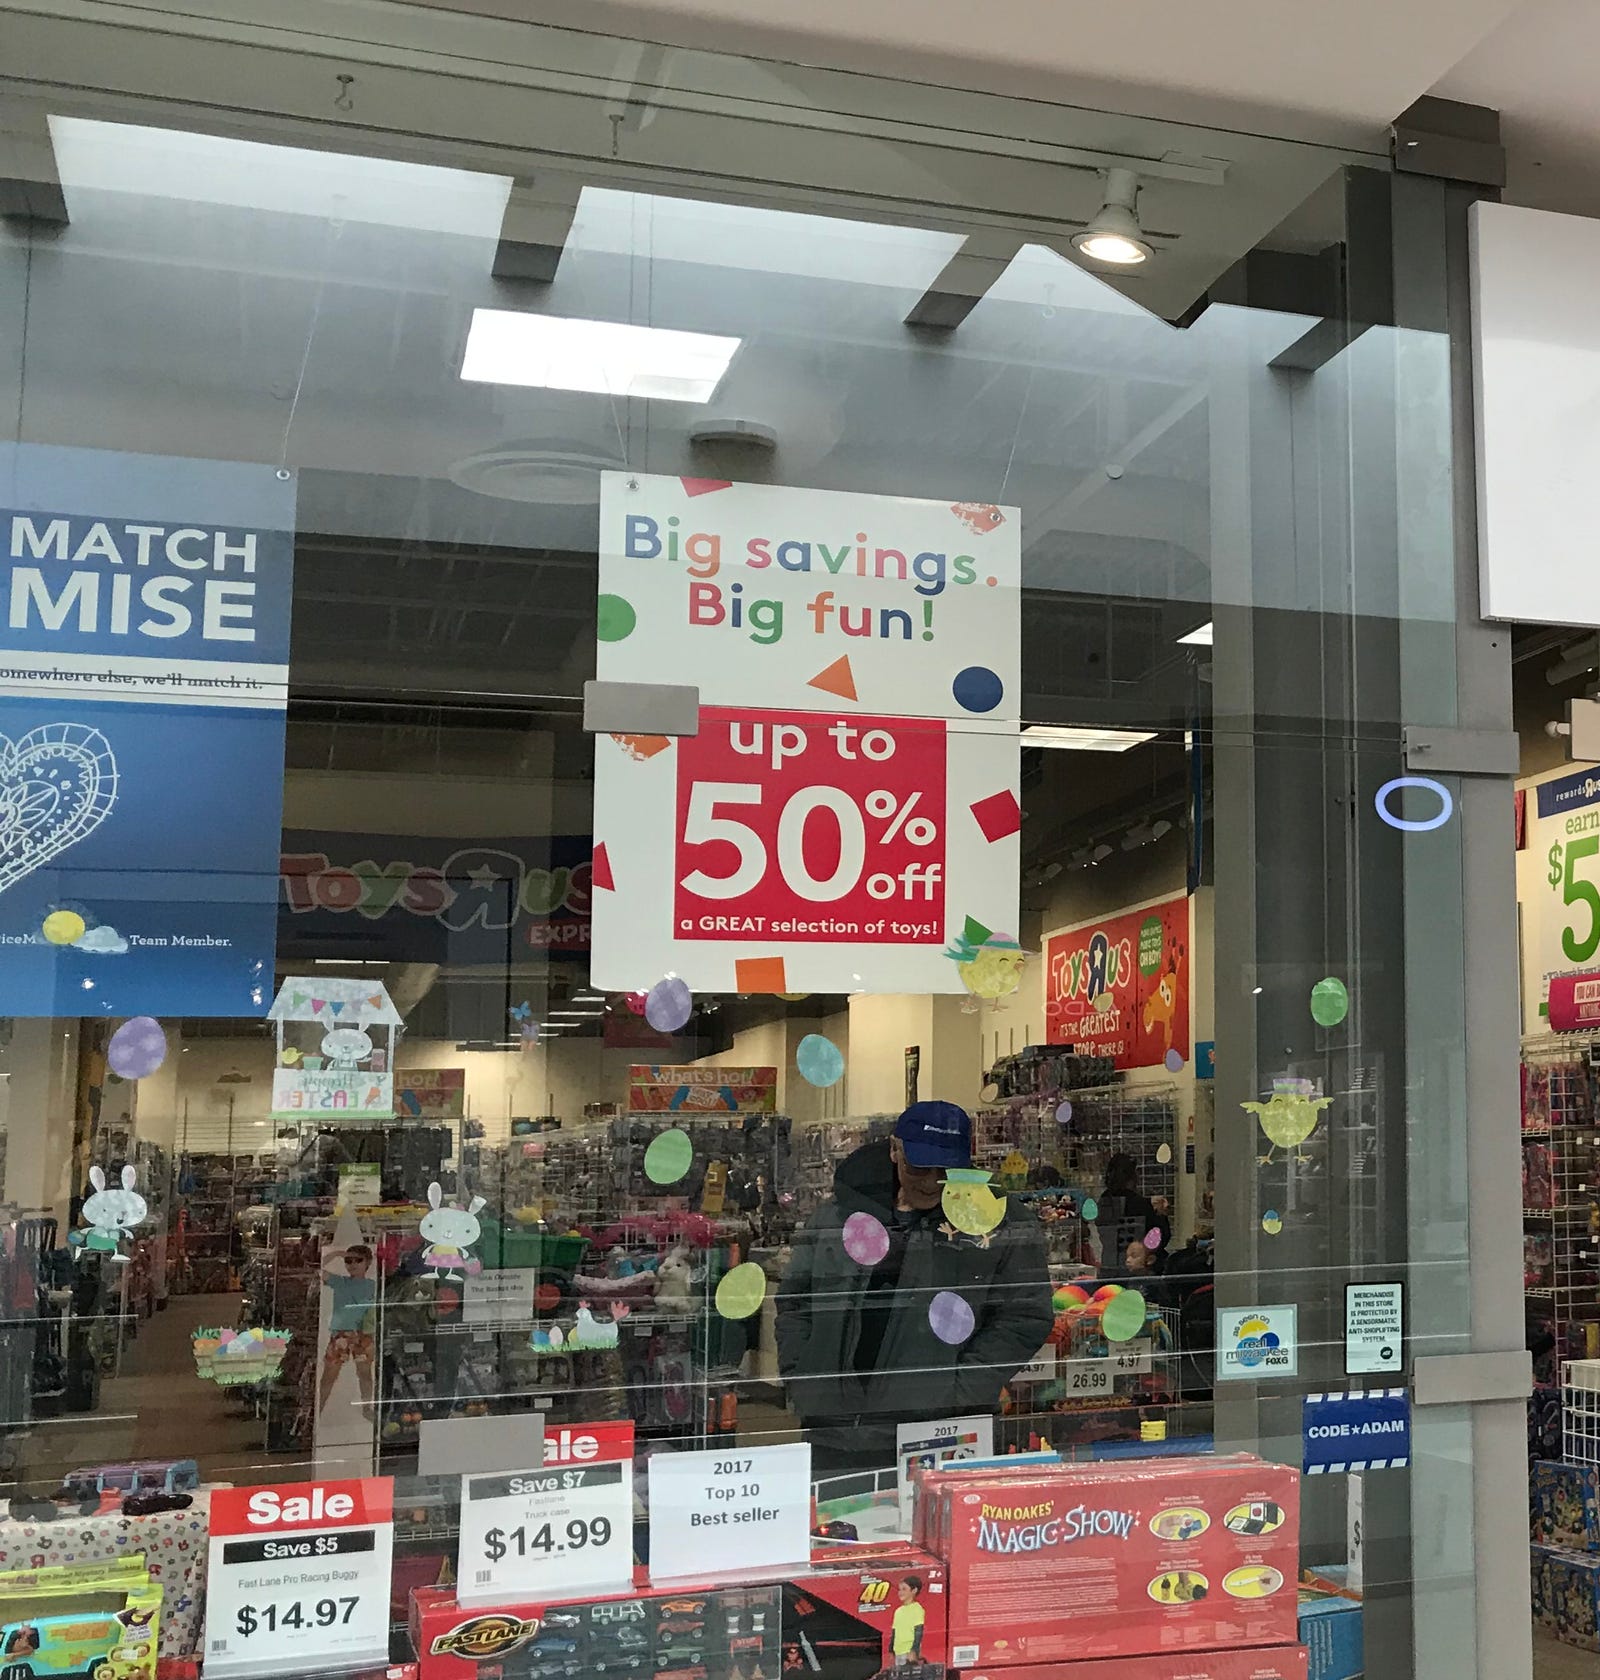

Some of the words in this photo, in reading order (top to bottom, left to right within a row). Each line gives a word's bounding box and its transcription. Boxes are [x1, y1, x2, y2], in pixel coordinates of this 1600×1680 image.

[9, 516, 257, 574] MATCH
[624, 514, 721, 578] Big
[745, 531, 998, 596] savings.
[8, 567, 256, 643] MISE
[689, 581, 784, 645] Big
[806, 590, 935, 642] fun!
[97, 670, 137, 686] else,
[187, 675, 241, 689] match
[245, 676, 263, 690] it.
[729, 721, 808, 770] up
[828, 719, 896, 762] to
[1565, 810, 1600, 835] earn
[679, 780, 937, 903] 50%
[865, 862, 942, 901] off
[680, 917, 694, 932] a
[699, 915, 767, 933] GREAT
[770, 916, 859, 935] selection
[864, 918, 886, 935] of
[890, 919, 939, 940] toys!
[129, 934, 168, 947] Team
[171, 934, 233, 948] Member.
[1353, 1291, 1395, 1299] MERCHANDISE
[1376, 1299, 1393, 1307] STORE
[1357, 1309, 1389, 1317] PROTECTED
[1243, 1338, 1267, 1349] real
[1072, 1373, 1107, 1389] 26.99
[934, 1425, 959, 1437] 2017
[1308, 1424, 1350, 1439] CODE
[1361, 1419, 1404, 1435] ADAM
[543, 1430, 599, 1462] ale
[713, 1459, 753, 1475] 2017
[508, 1476, 559, 1495] Save
[562, 1471, 586, 1489] $7
[704, 1487, 736, 1501] Top
[741, 1483, 760, 1497] 10
[246, 1487, 355, 1525] Sale
[690, 1511, 728, 1527] Best
[732, 1506, 780, 1523] seller
[981, 1503, 1012, 1521] RYAN
[483, 1516, 613, 1564] $14.99
[977, 1515, 1060, 1554] MAGIC
[1063, 1504, 1134, 1541] SHOW
[263, 1542, 311, 1559] Save
[315, 1536, 338, 1555] $5
[238, 1578, 257, 1589] Fast
[259, 1577, 281, 1588] Lane
[283, 1575, 298, 1585] Pro
[300, 1572, 330, 1584] Racing
[332, 1569, 360, 1582] Buggy
[859, 1581, 891, 1604] 40
[236, 1596, 360, 1638] $14.97
